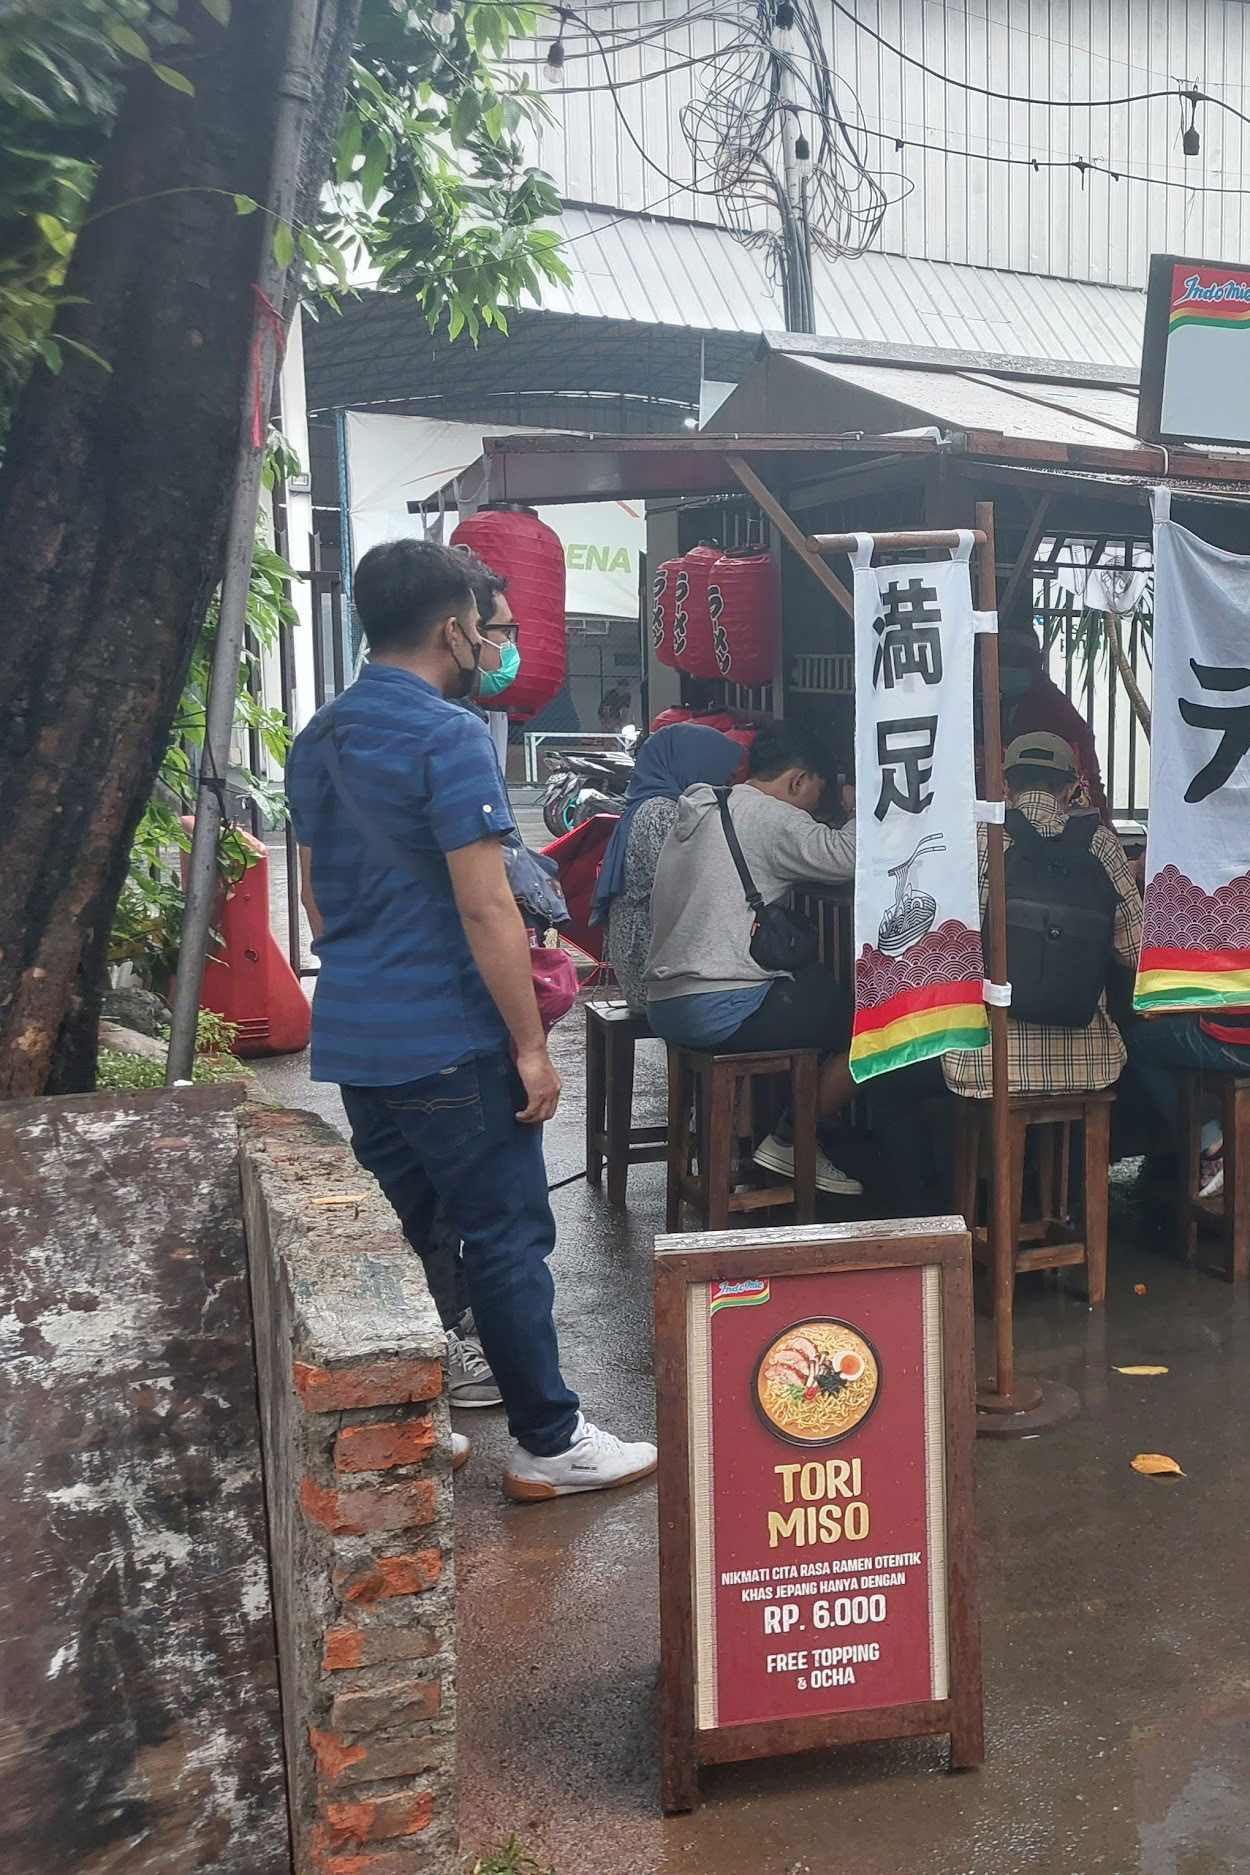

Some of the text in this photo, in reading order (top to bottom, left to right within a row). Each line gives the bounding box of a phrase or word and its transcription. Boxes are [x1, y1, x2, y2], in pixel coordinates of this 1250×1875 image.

[564, 543, 632, 574] ENA
[872, 577, 944, 822] 満足
[774, 1457, 863, 1504] TORI
[767, 1501, 870, 1549] MISO
[721, 1551, 922, 1586] NIKMATI CITA RASA RAMEN OTENTIK
[741, 1571, 906, 1602] KHAS JEPANG HANYA DENGAN
[764, 1593, 887, 1635] RP. 6.000
[767, 1642, 880, 1673] FREE TOPPING
[797, 1666, 856, 1690] & OCHA
